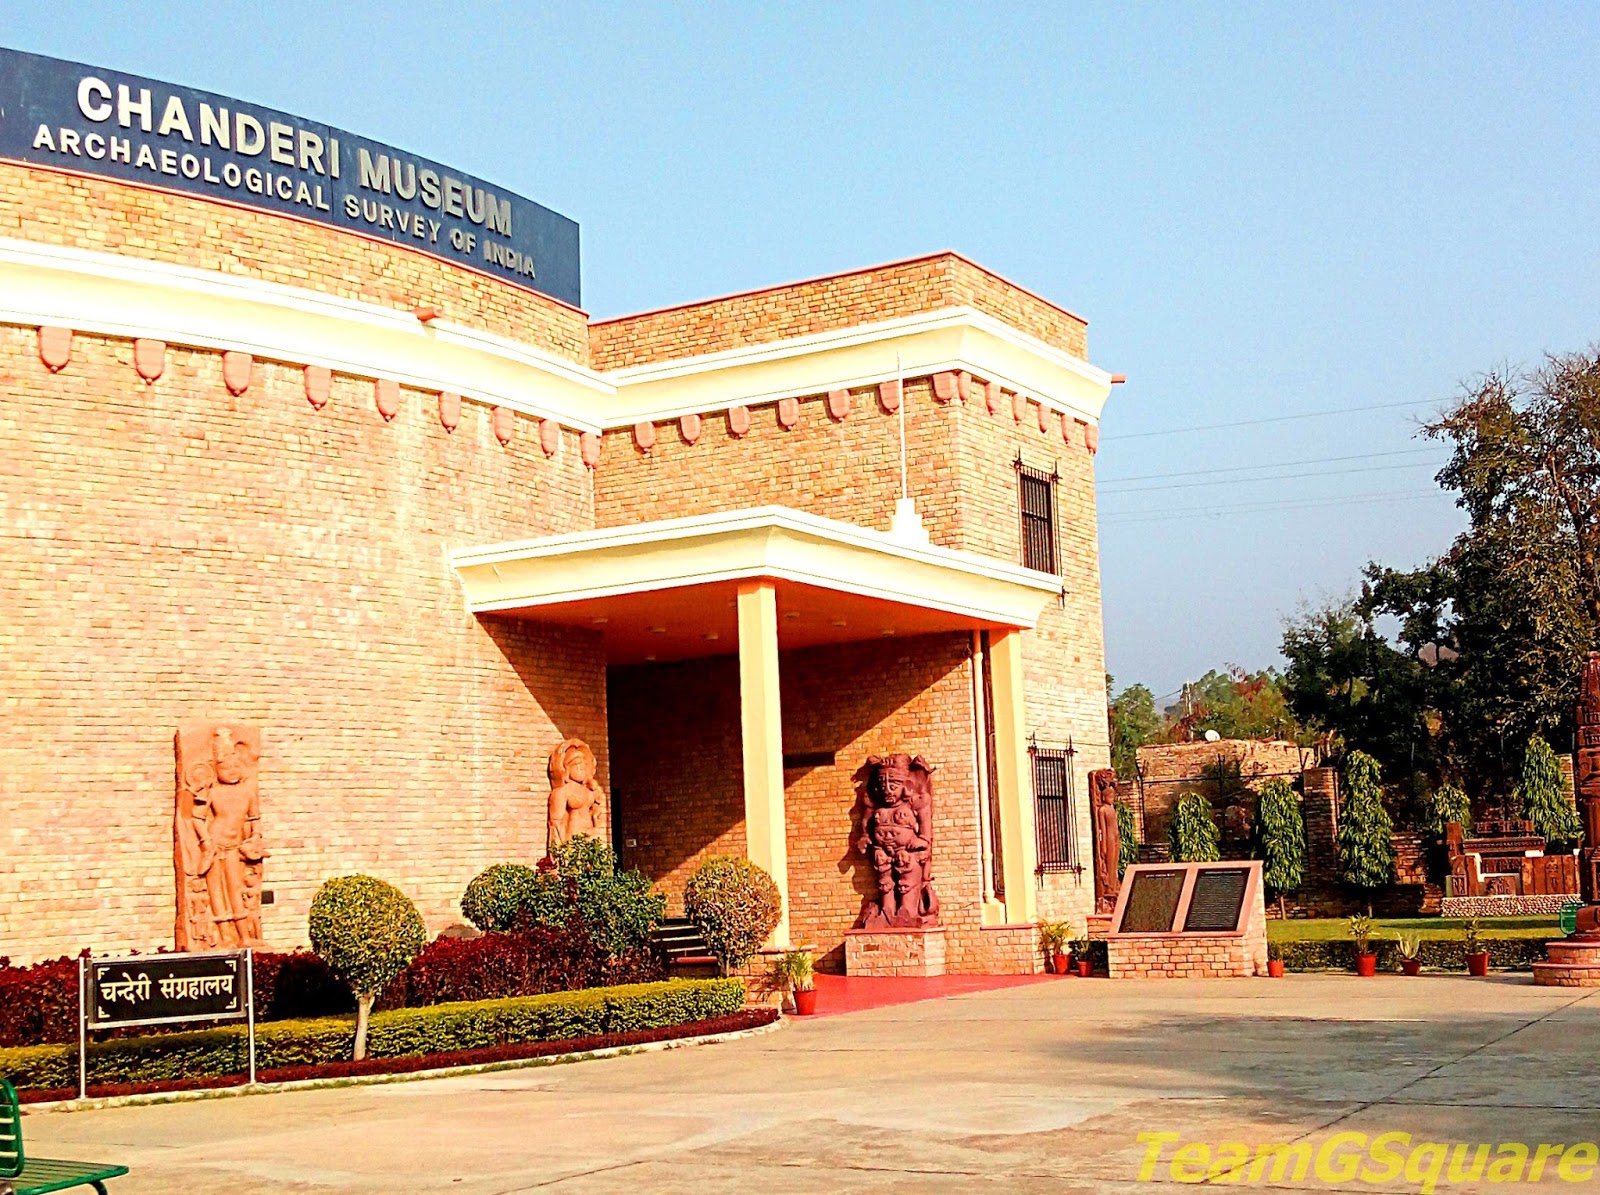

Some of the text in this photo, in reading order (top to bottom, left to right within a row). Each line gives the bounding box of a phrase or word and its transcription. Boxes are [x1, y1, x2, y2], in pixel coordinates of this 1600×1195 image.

[32, 124, 536, 279] ARCHAEOLOGICAL SURVEY OF INDIA
[77, 76, 512, 238] CHANDERI MUSEUM
[100, 972, 235, 1004] चन्देरी संग्रहालय
